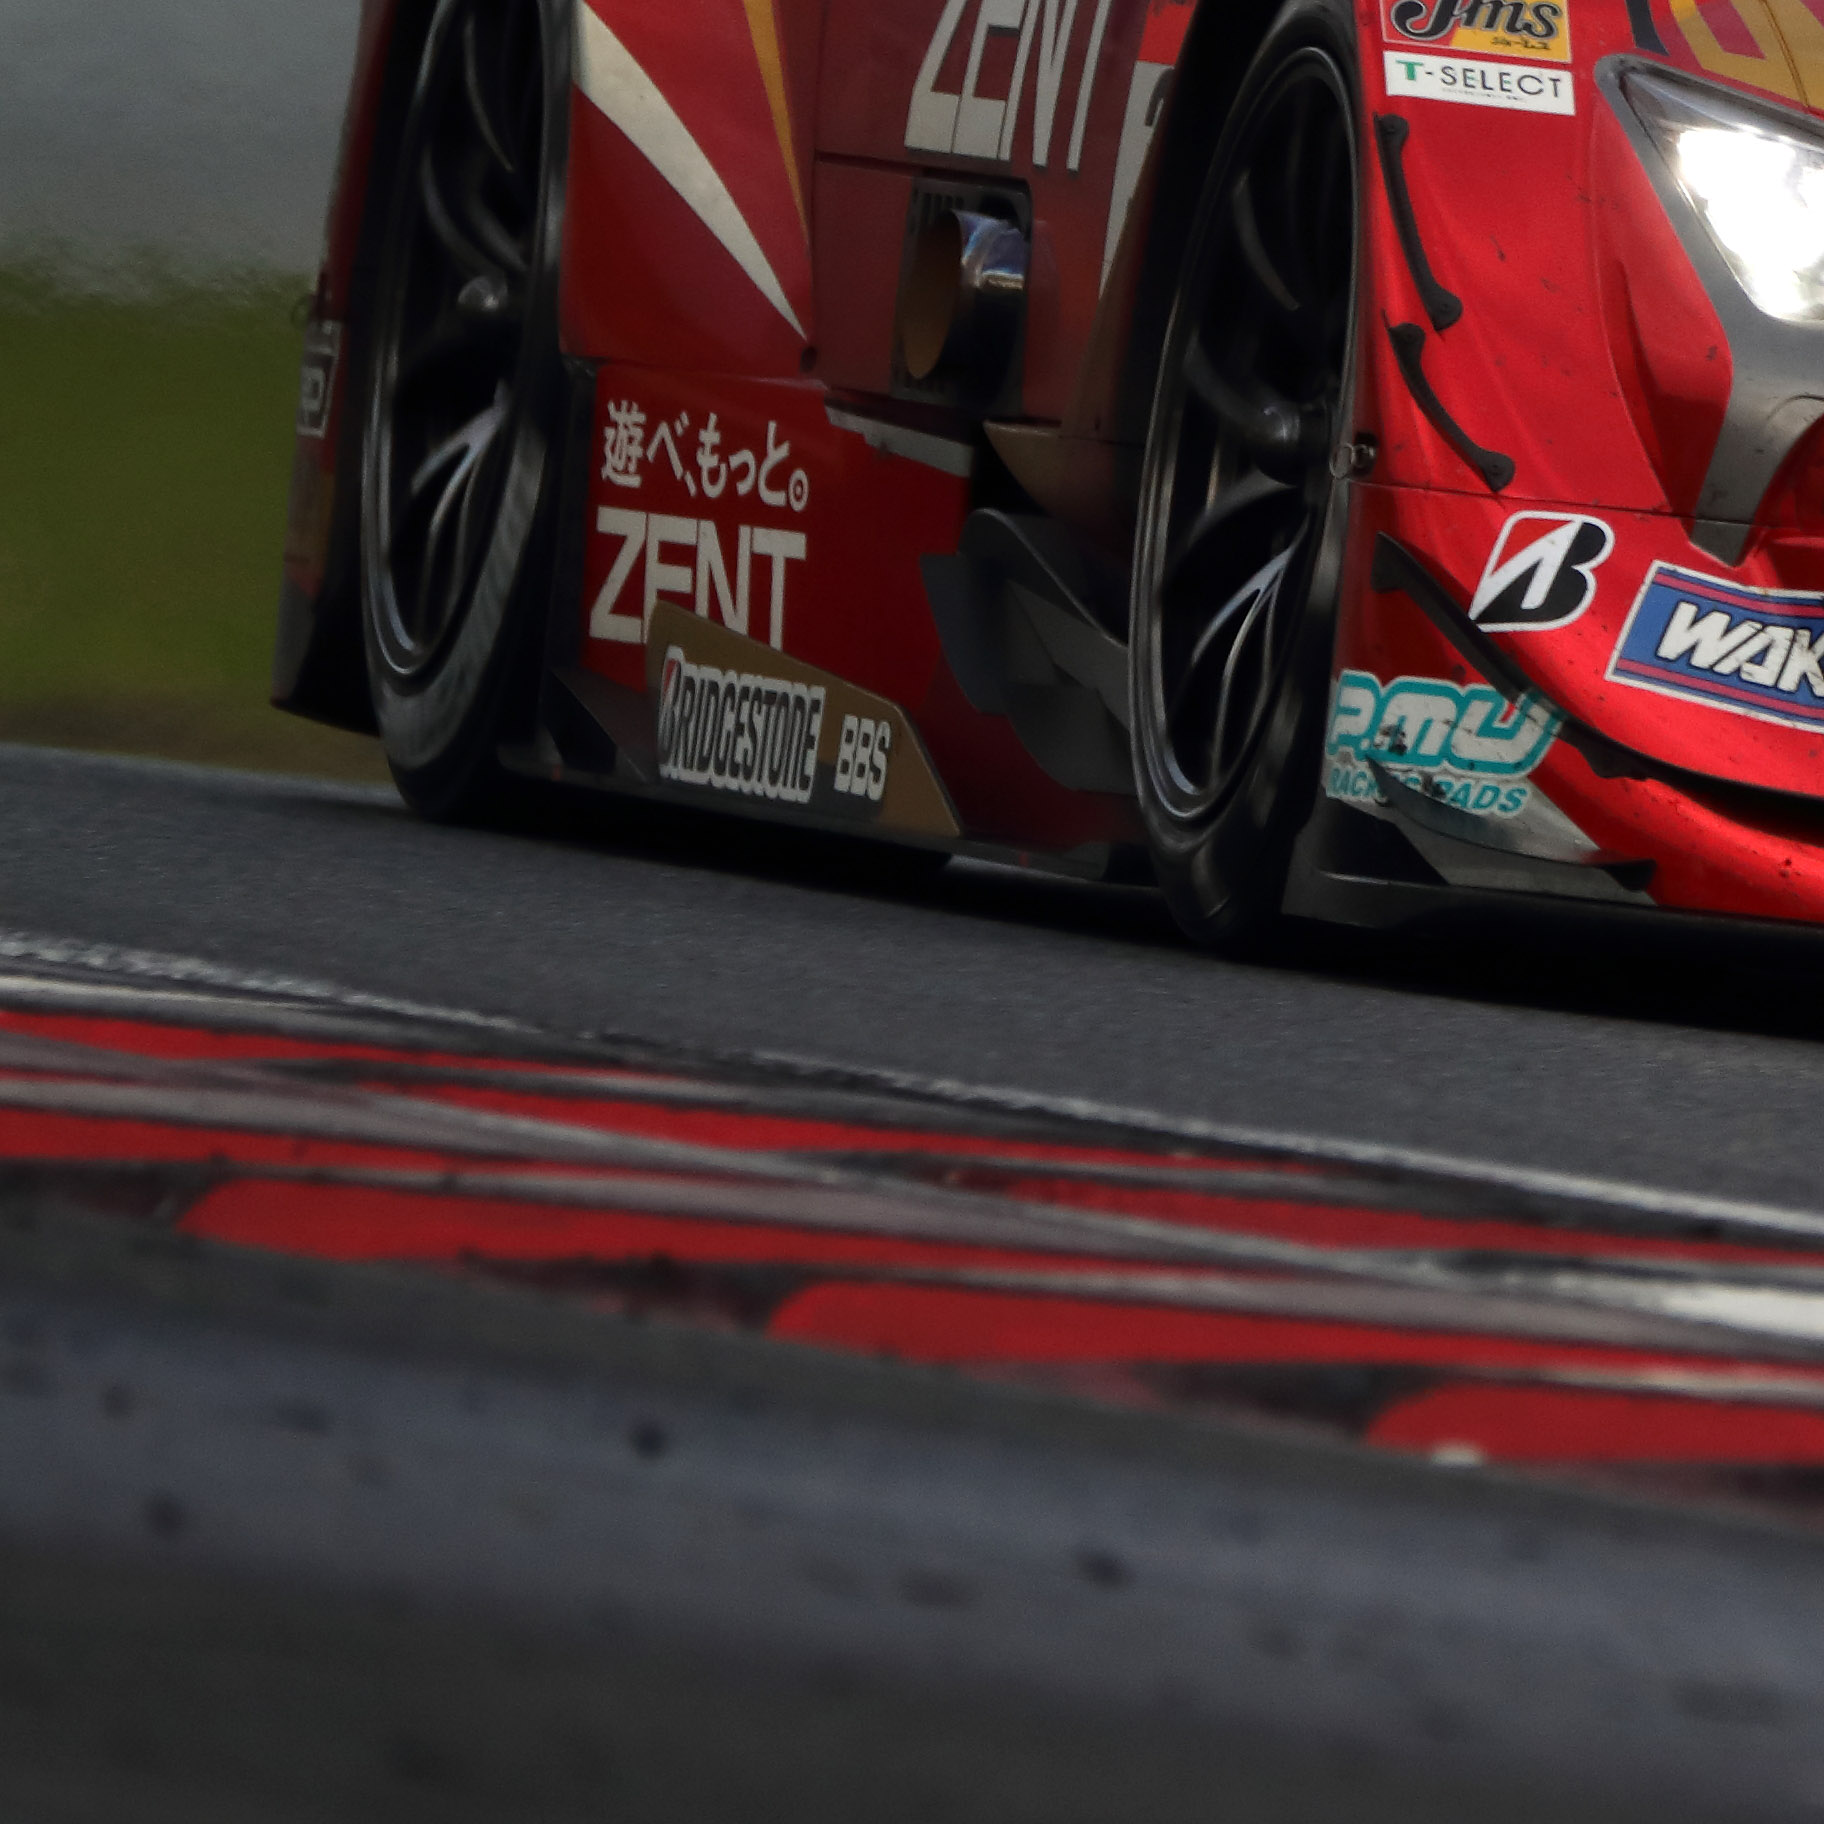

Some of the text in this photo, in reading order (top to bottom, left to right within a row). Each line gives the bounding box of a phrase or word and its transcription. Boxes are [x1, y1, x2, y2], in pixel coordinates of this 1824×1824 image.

[1396, 59, 1561, 98] T-SELECT
[589, 506, 807, 651] ZENT
[659, 649, 891, 801] BRIDGESTONE BBS
